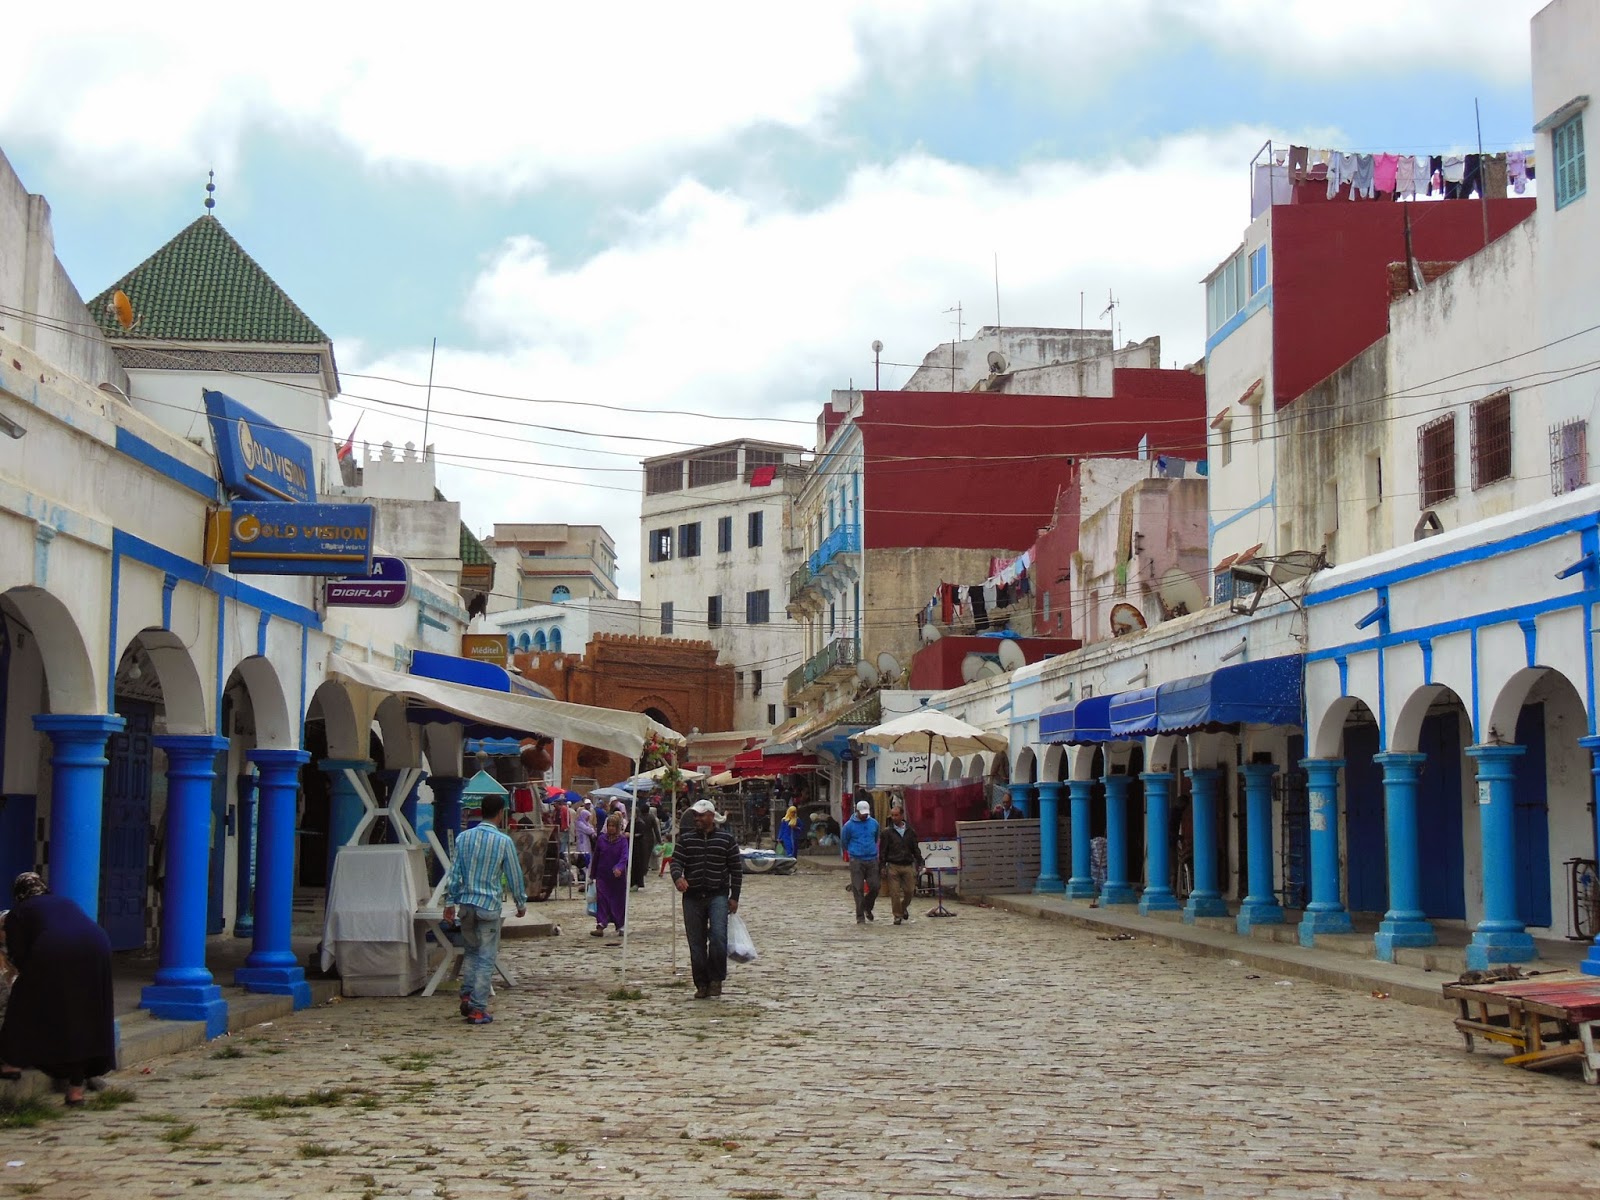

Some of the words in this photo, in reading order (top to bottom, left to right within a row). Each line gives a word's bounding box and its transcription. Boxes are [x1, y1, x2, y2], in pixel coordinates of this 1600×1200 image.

[237, 417, 274, 473] GOLD
[233, 514, 298, 544] GOLD
[302, 525, 367, 541] VISION
[331, 588, 392, 598] DIGIFLAT
[471, 646, 499, 654] Méditel
[926, 842, 952, 851] حلاقة
